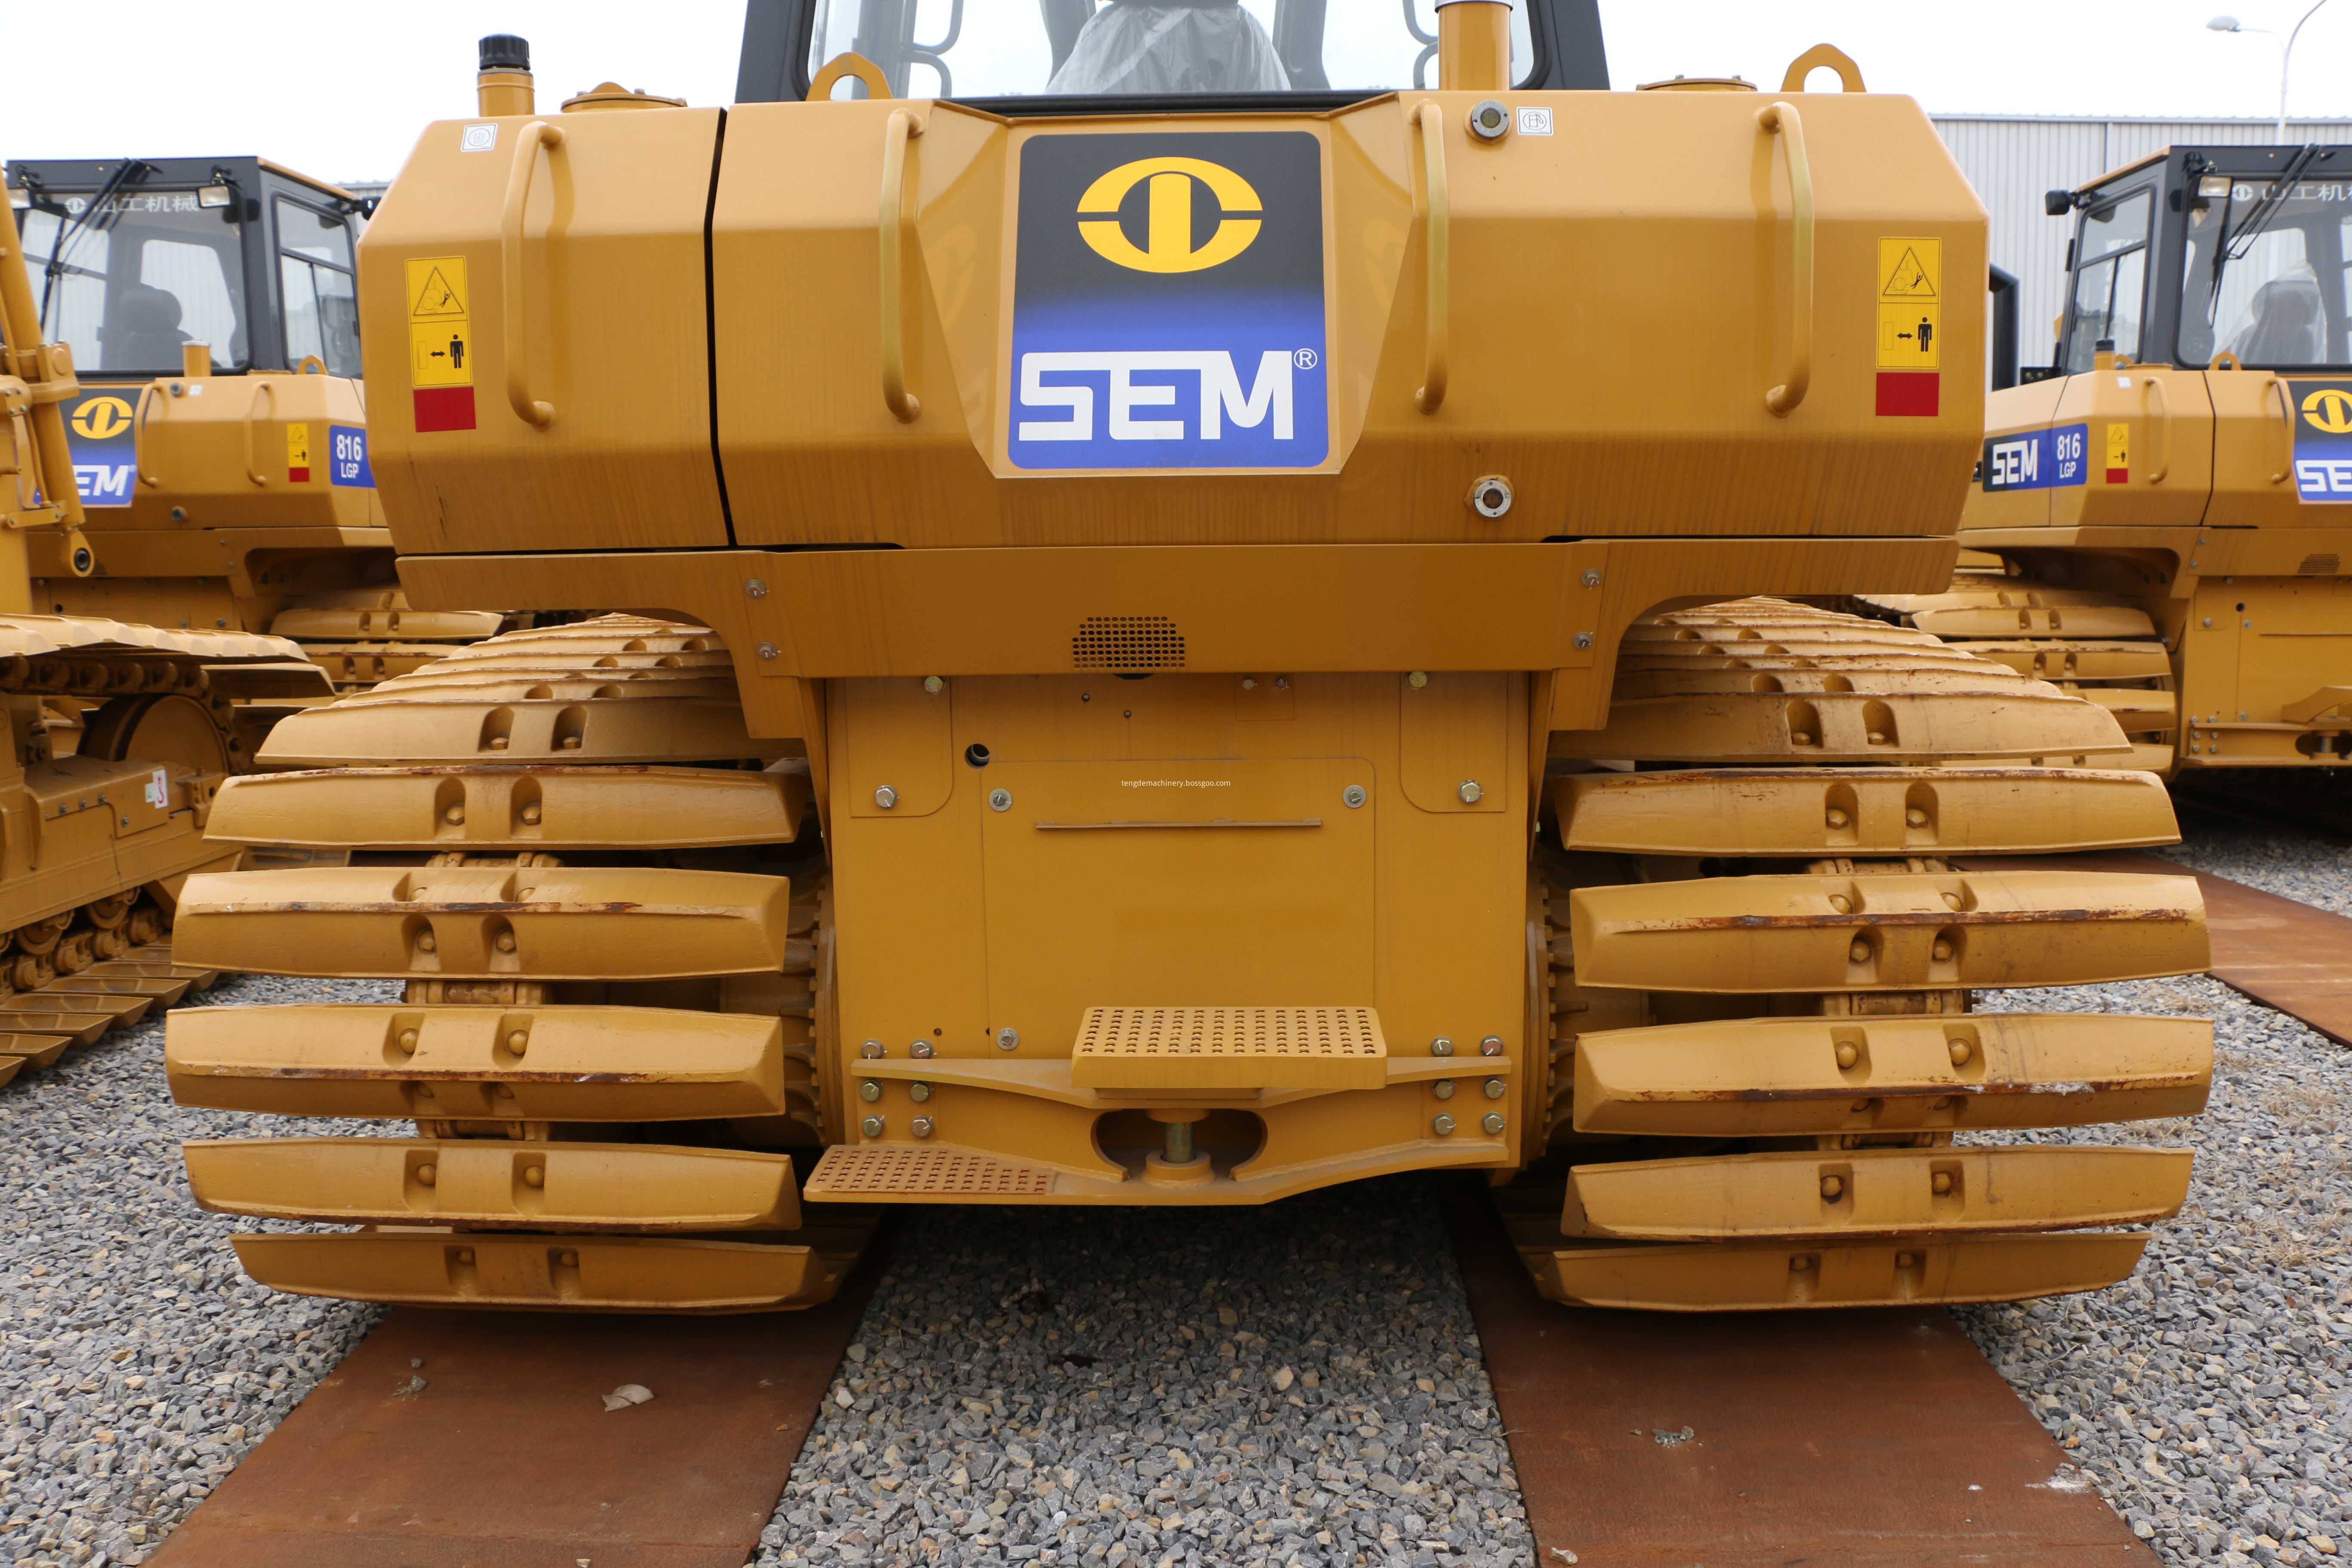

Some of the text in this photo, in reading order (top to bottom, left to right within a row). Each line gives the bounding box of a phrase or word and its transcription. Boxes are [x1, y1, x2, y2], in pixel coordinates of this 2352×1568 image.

[337, 434, 362, 461] 816
[2057, 432, 2081, 460] 816
[340, 462, 359, 478] LGP
[1992, 438, 2038, 485] SEM
[2059, 461, 2076, 478] LGP
